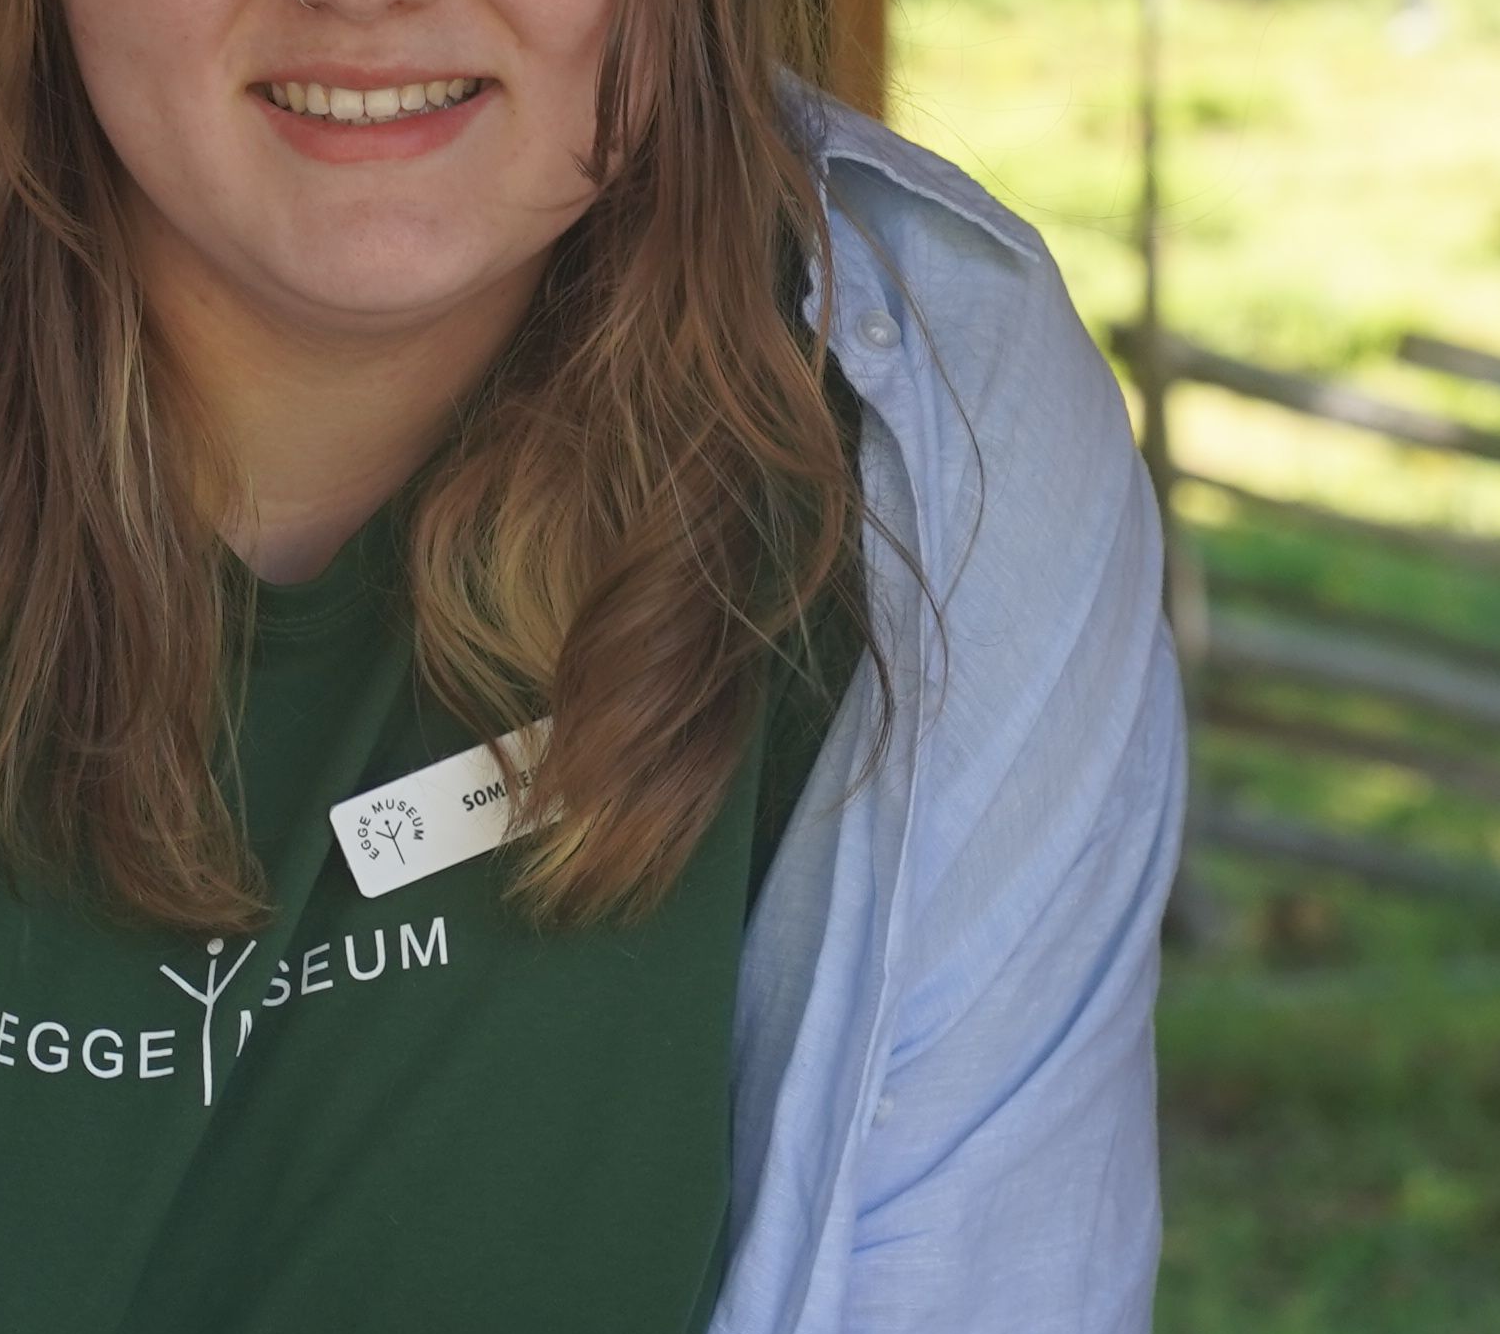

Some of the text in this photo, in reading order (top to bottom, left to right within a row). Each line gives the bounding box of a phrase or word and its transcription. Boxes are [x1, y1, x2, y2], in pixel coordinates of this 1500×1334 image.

[357, 798, 426, 860] EGGE MUSEUM
[235, 916, 449, 1059] SEUM
